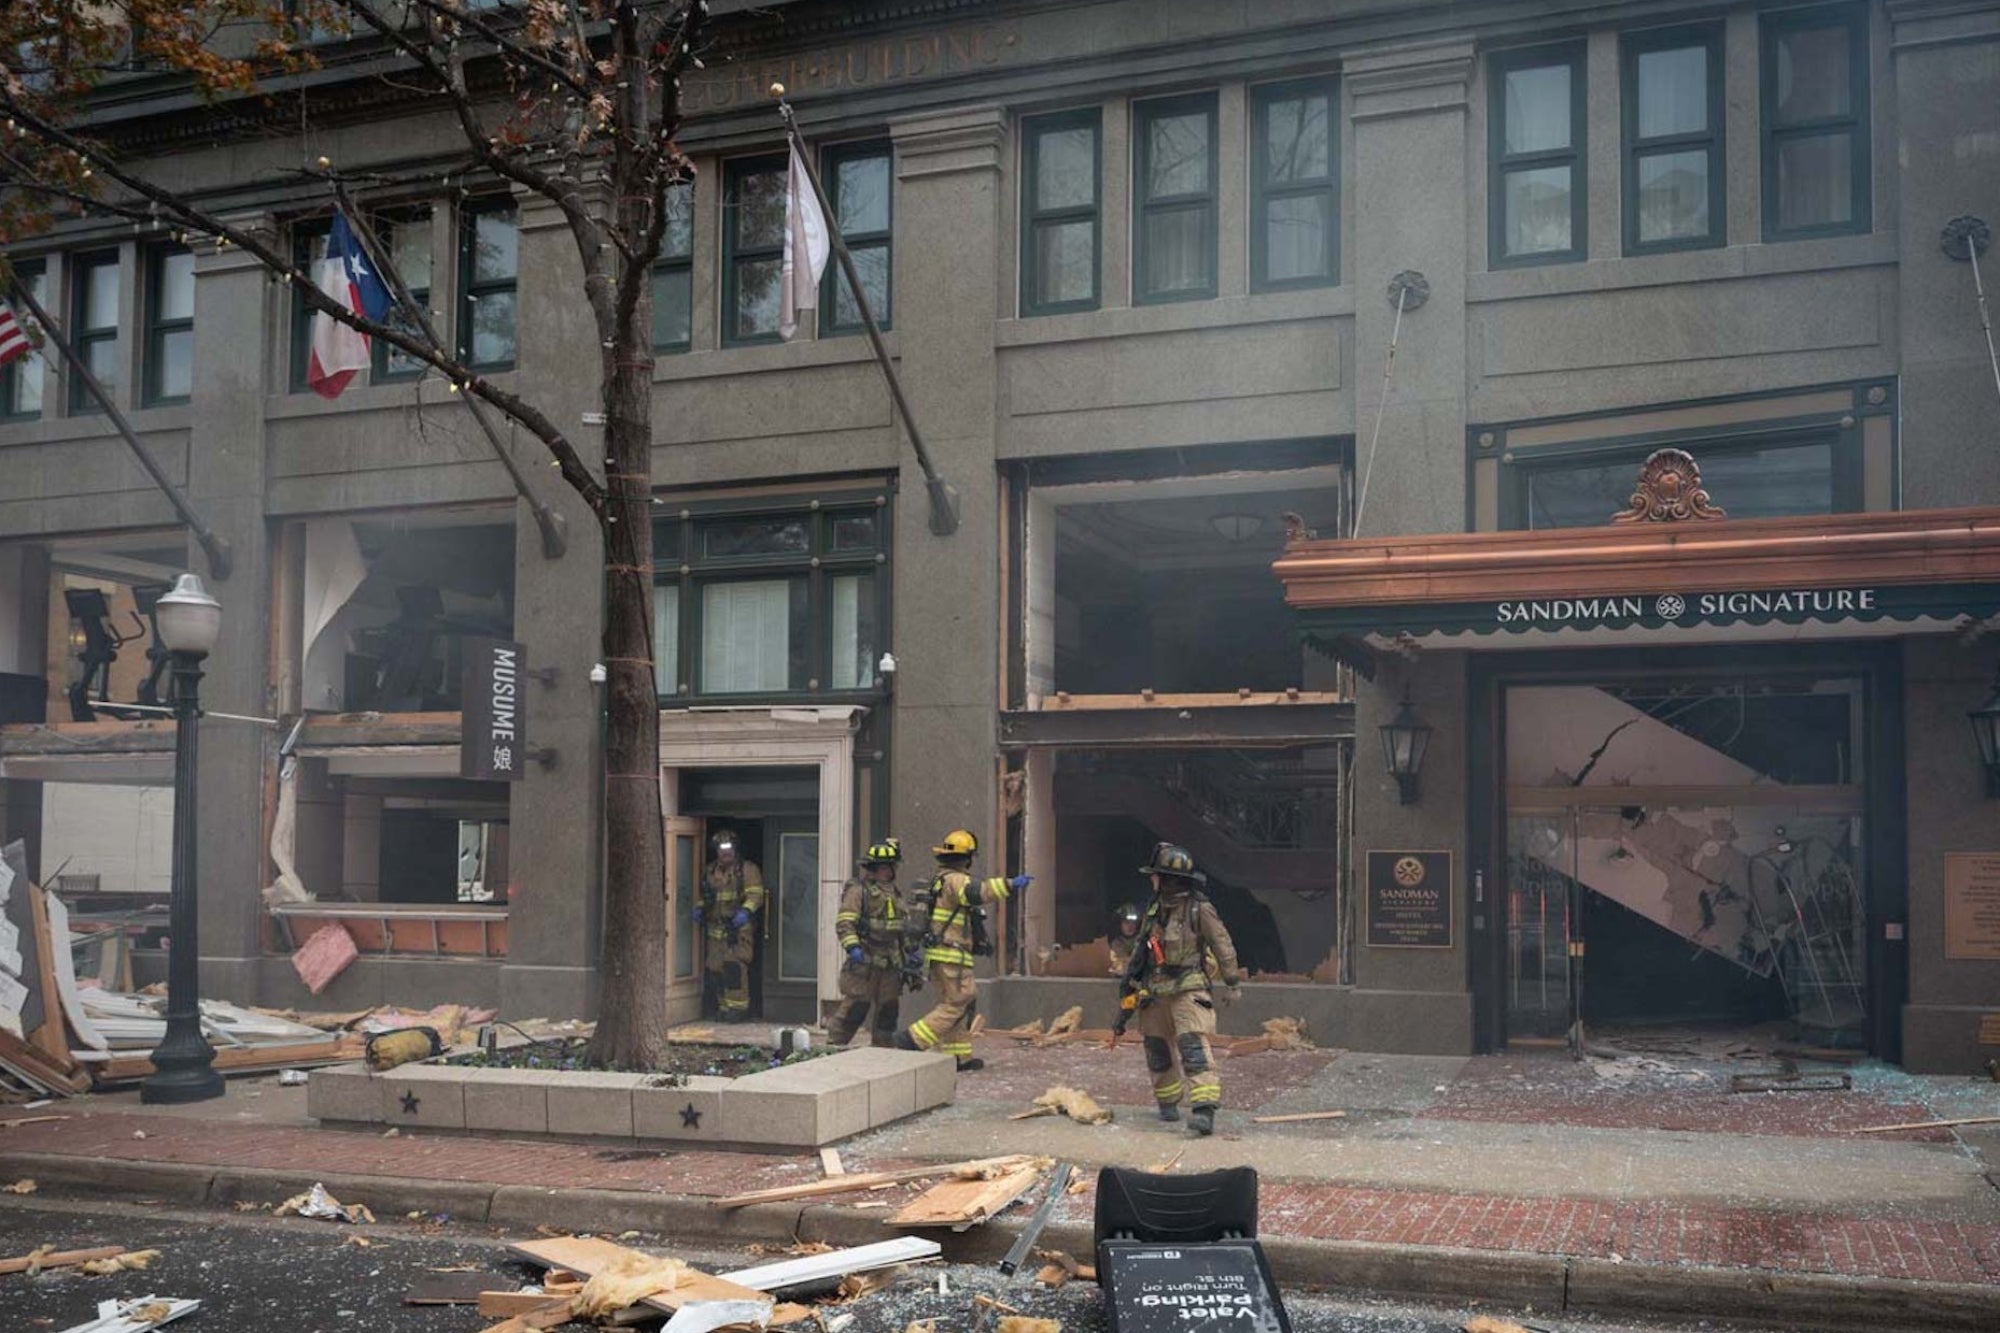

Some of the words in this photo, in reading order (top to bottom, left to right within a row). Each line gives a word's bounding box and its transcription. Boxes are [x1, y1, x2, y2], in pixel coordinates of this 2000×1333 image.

[822, 26, 1000, 88] BUILDING
[1496, 598, 1642, 622] SANDMAN
[1700, 590, 1875, 614] SIGNATURE
[492, 648, 516, 741] MUSUME
[1380, 888, 1439, 899] SANDMAN
[1142, 1283, 1162, 1292] on
[1167, 1282, 1209, 1291] Right
[1212, 1283, 1247, 1291] Turn
[1178, 1306, 1258, 1319] Valet
